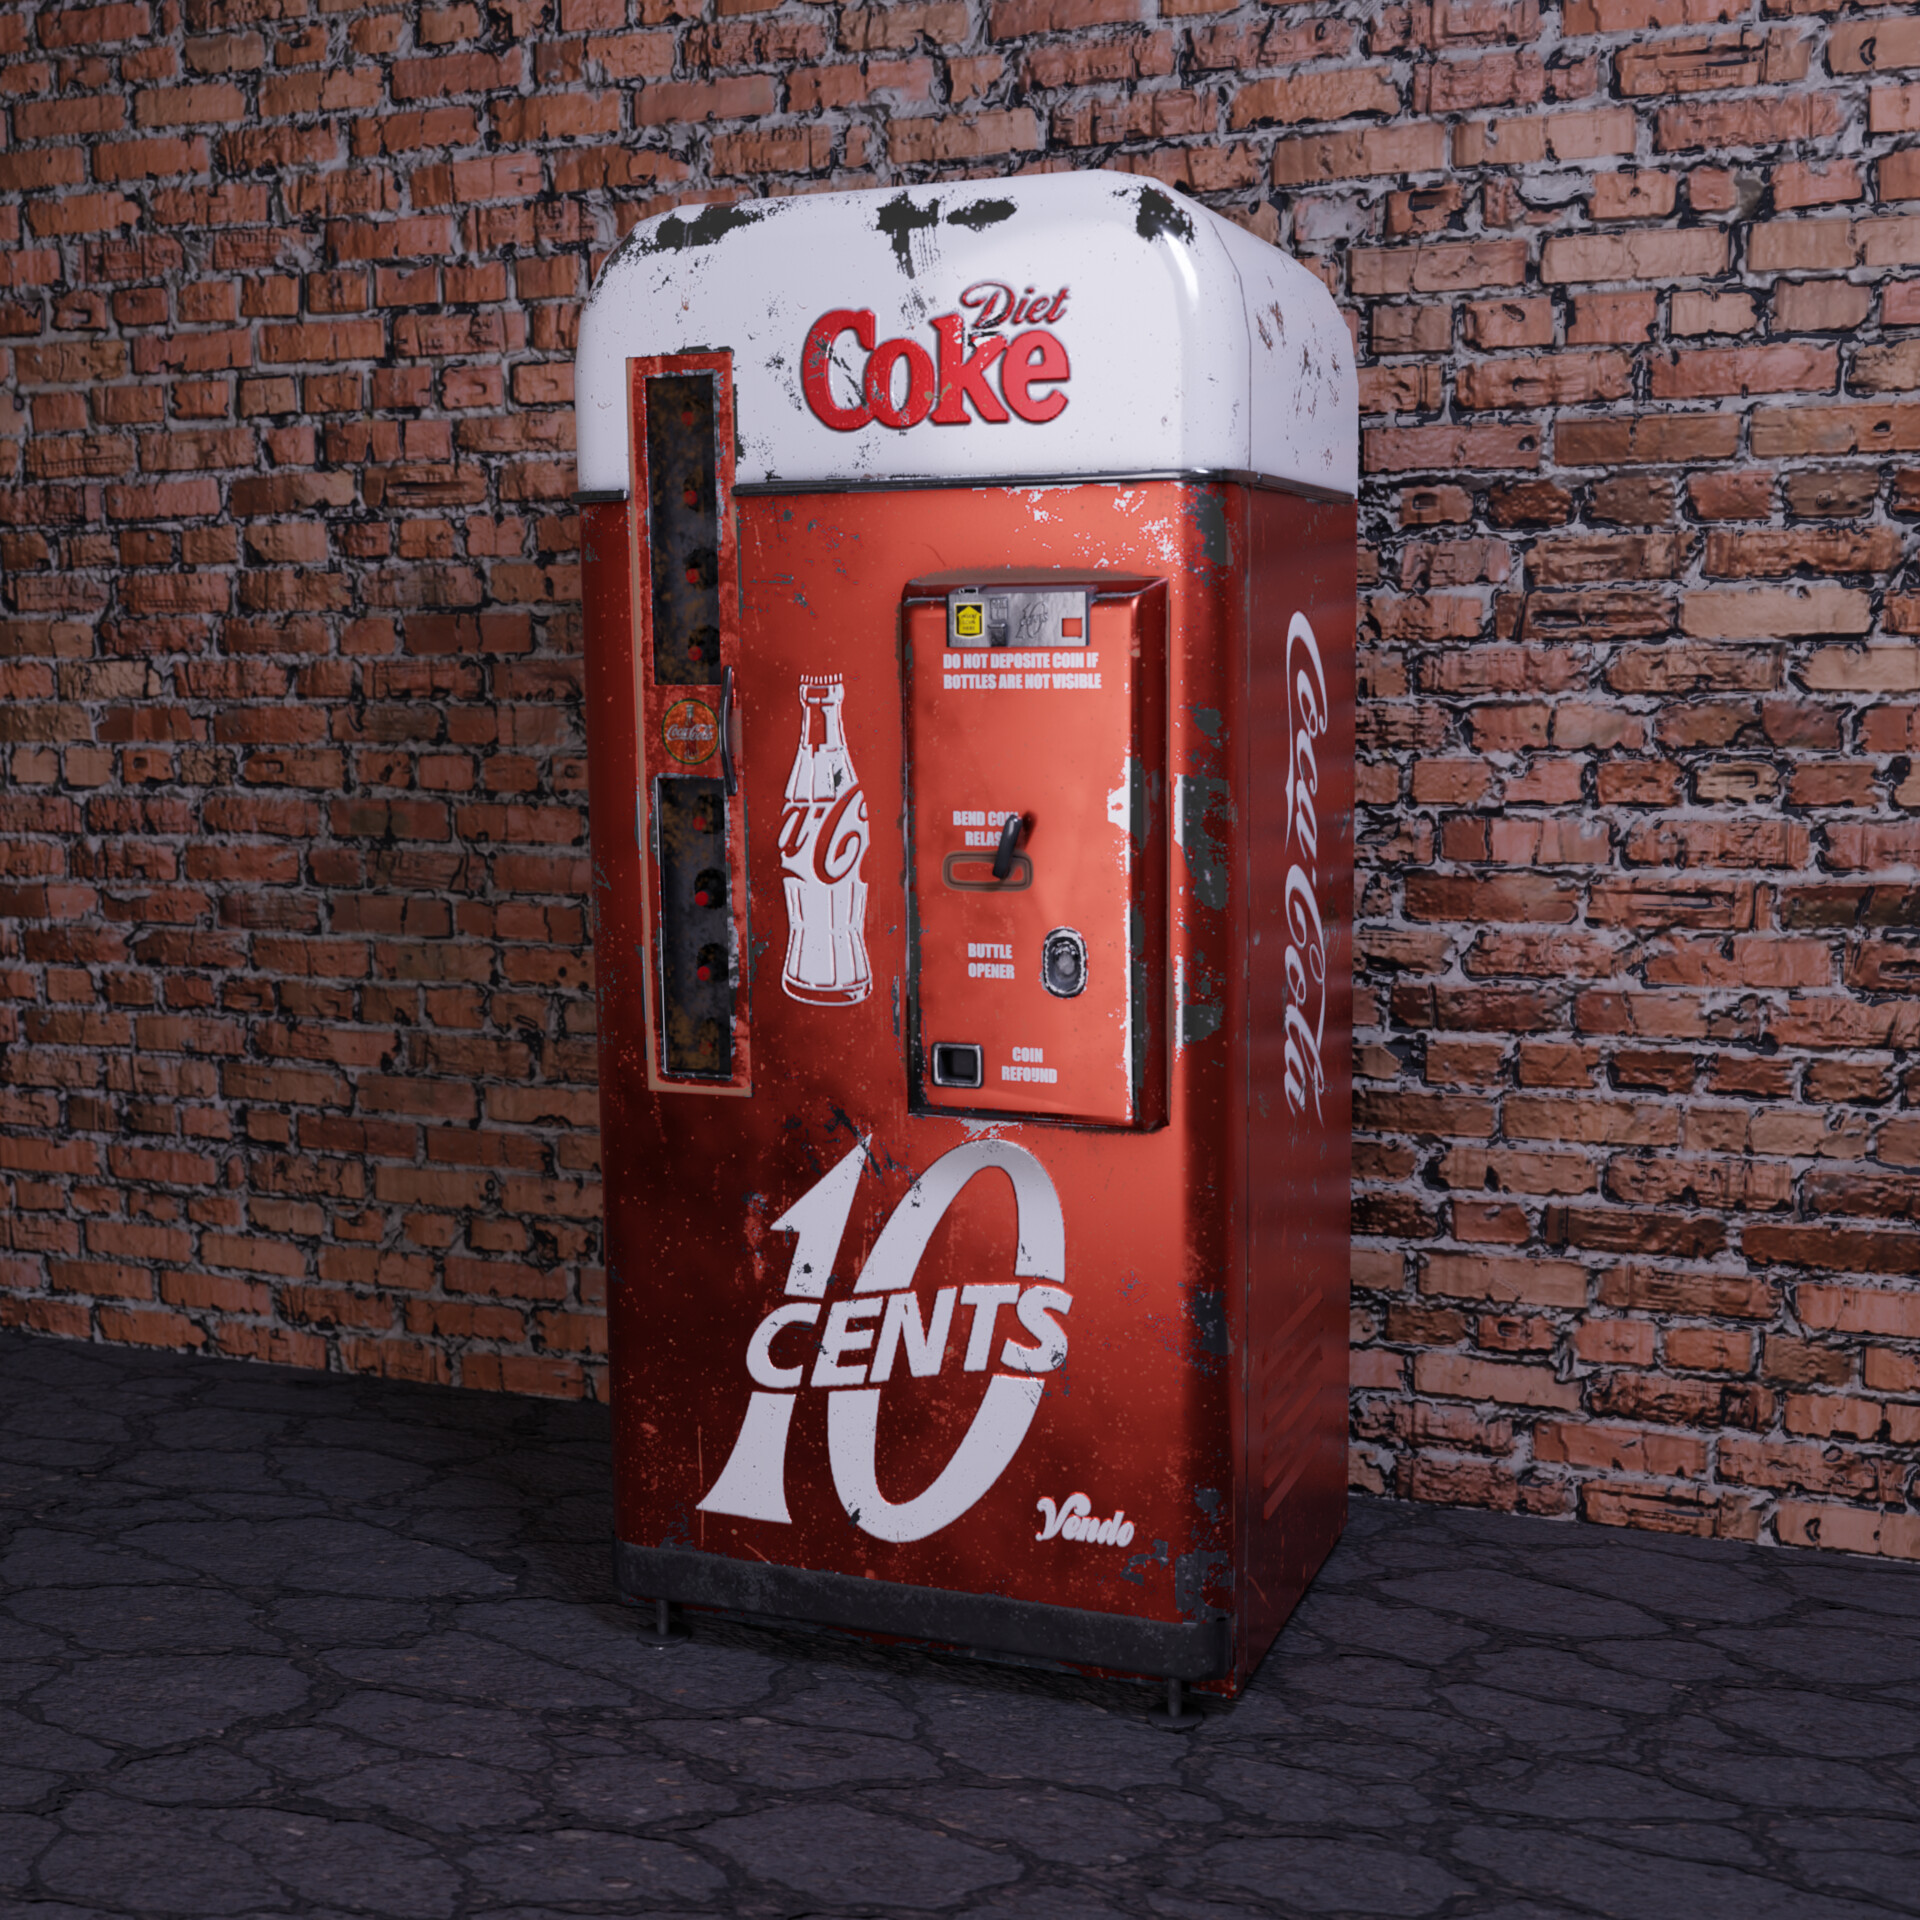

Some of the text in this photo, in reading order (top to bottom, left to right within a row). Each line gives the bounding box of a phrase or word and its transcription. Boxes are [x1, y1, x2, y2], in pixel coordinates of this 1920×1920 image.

[958, 280, 1072, 328] Diet
[800, 307, 1072, 433] Coke
[943, 652, 1099, 669] DO NOT DEPOSITE COIN IF
[943, 673, 1102, 689] BOTTLES ARE NOT VISIBLE
[952, 810, 1019, 827] BEND COI
[965, 831, 1003, 846] RELAS
[1283, 610, 1328, 1129] Coca-Cola
[967, 962, 1015, 979] OPENER
[1012, 1046, 1043, 1063] COIN
[1001, 1065, 1058, 1083] REFOUND
[695, 1132, 1066, 1543] 10
[745, 1282, 1073, 1389] CENTS
[1034, 1491, 1135, 1547] Vendo
